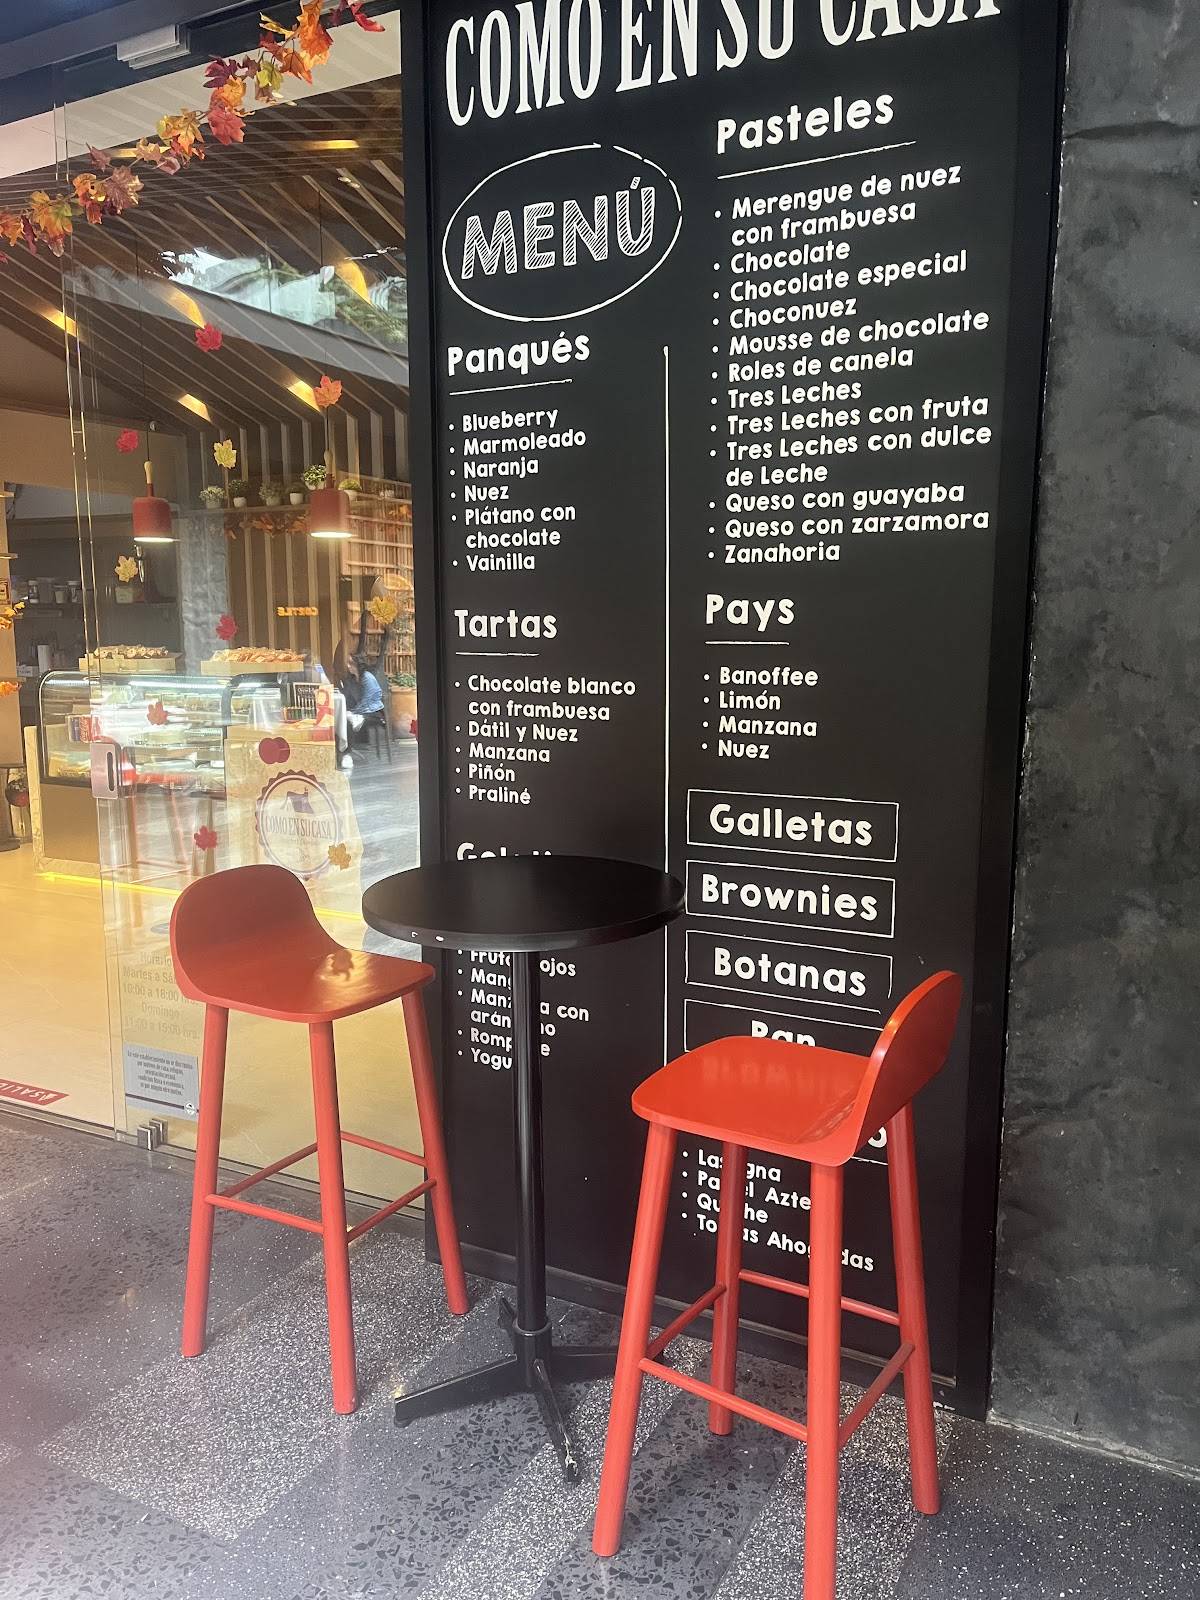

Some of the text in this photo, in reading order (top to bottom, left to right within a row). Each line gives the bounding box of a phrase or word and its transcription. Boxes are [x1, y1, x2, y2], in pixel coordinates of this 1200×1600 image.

[446, 0, 602, 126] COMO
[616, 0, 697, 92] EN
[717, 0, 793, 71] SU
[718, 95, 893, 154] Pasteles
[732, 166, 961, 219] Merengue de nuez
[461, 177, 655, 279] MENÚ
[732, 203, 915, 246] con frambuesa
[731, 240, 850, 273] Chocolate
[731, 250, 966, 301] Chocolate especial
[730, 298, 856, 329] Choconuez
[730, 310, 989, 356] Mousse de chocolate
[448, 331, 589, 376] Panqués
[729, 347, 913, 382] Roles de canela
[728, 381, 861, 408] Tres Leches
[463, 410, 558, 432] Blueberry
[728, 396, 988, 434] Tres Leches con fruta
[464, 429, 586, 455] Marmoleado
[727, 425, 991, 460] Tres Leches con dulce
[464, 457, 538, 478] Naranja
[726, 463, 827, 486] de Leche
[465, 485, 509, 502] Nuez
[726, 483, 964, 512] Queso con guayaba
[466, 506, 575, 525] Plátano con
[725, 512, 989, 538] Queso con zarzamora
[466, 528, 560, 548] chocolate
[466, 553, 535, 571] Vainilla
[725, 541, 840, 563] Zanahoria
[454, 610, 557, 638] Tartas
[706, 594, 794, 631] Pays
[468, 675, 635, 695] Chocolate blanco
[720, 667, 818, 686] Banoffee
[469, 700, 609, 720] con frambuesa
[720, 690, 780, 710] Limón
[469, 719, 578, 742] Dátil y Nuez
[719, 716, 817, 736] Manzana
[469, 743, 549, 762] Manzana
[719, 740, 769, 759] Nuez
[469, 763, 515, 781] Piñón
[469, 785, 530, 804] Praliné
[300, 818, 311, 838] SU
[710, 804, 872, 846] Galletas
[702, 874, 877, 920] Brownies
[540, 958, 575, 976] ojos
[715, 947, 865, 996] Botanas
[557, 1006, 589, 1021] con
[697, 1193, 768, 1223] Quhe
[765, 1187, 810, 1210] Azte
[767, 1231, 873, 1271] Ahodas
